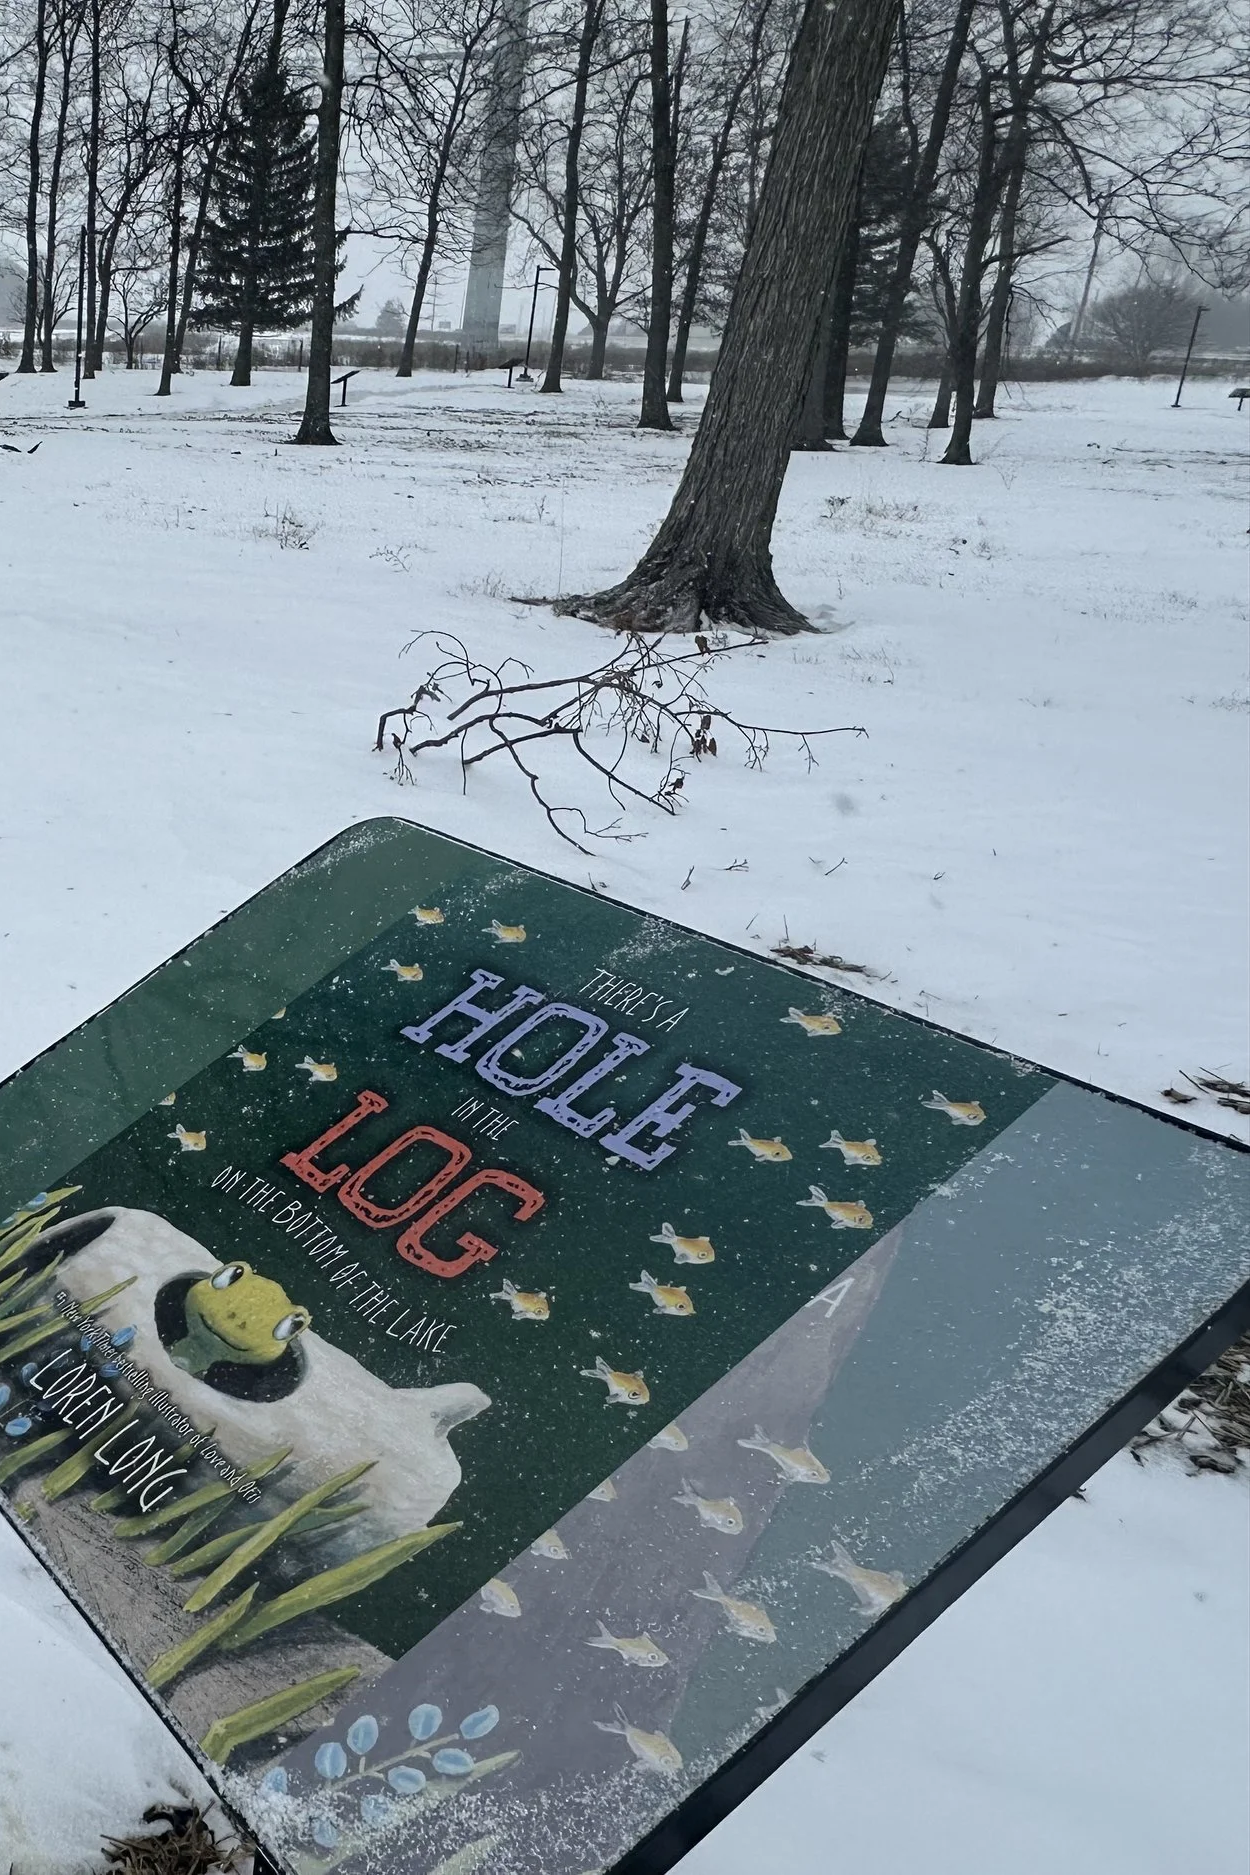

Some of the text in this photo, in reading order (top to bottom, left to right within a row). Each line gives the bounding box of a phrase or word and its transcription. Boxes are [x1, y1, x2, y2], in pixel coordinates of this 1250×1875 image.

[400, 969, 742, 1170] HOLE
[579, 968, 689, 1032] THERE'S A
[279, 1090, 546, 1277] LOG
[451, 1096, 519, 1141] IN THE
[211, 1165, 458, 1353] ON THE BOTTOM OF THE LAKE
[29, 1348, 188, 1513] LOREN LONG
[60, 1301, 82, 1322] New
[76, 1315, 102, 1340] York
[93, 1332, 119, 1359] Times
[189, 1433, 210, 1448] of
[200, 1442, 226, 1468] Love
[219, 1465, 248, 1488] and
